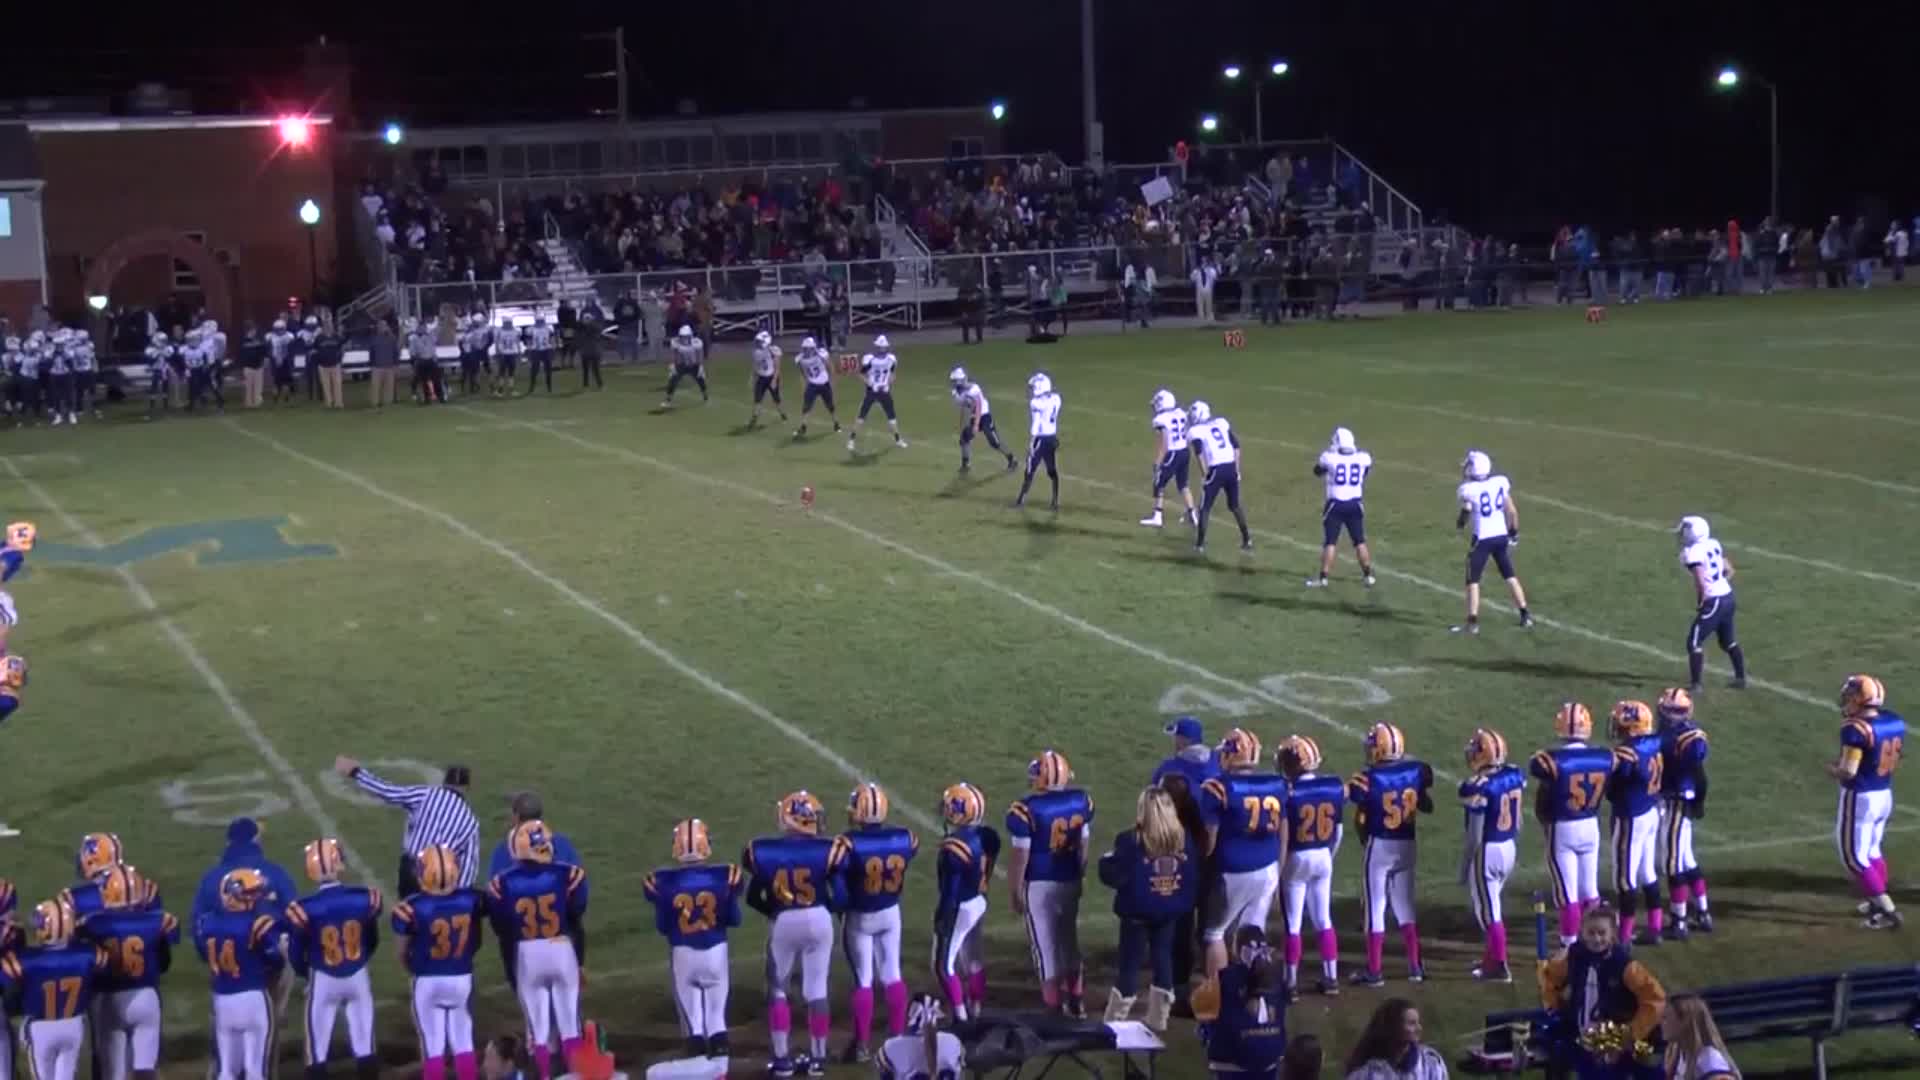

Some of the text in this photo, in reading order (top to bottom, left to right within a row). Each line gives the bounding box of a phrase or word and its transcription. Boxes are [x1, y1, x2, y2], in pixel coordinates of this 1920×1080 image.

[1211, 426, 1226, 449] 9
[1334, 463, 1361, 486] 88
[1479, 487, 1505, 518] 84
[1567, 773, 1606, 811] 57
[1243, 796, 1281, 833] 73
[1296, 802, 1335, 843] 26
[773, 868, 816, 907] 45
[864, 856, 905, 894] 83
[515, 894, 560, 941] 35
[672, 892, 718, 935] 23
[430, 914, 471, 960] 37
[207, 937, 241, 980] 14
[42, 976, 83, 1022] 17
